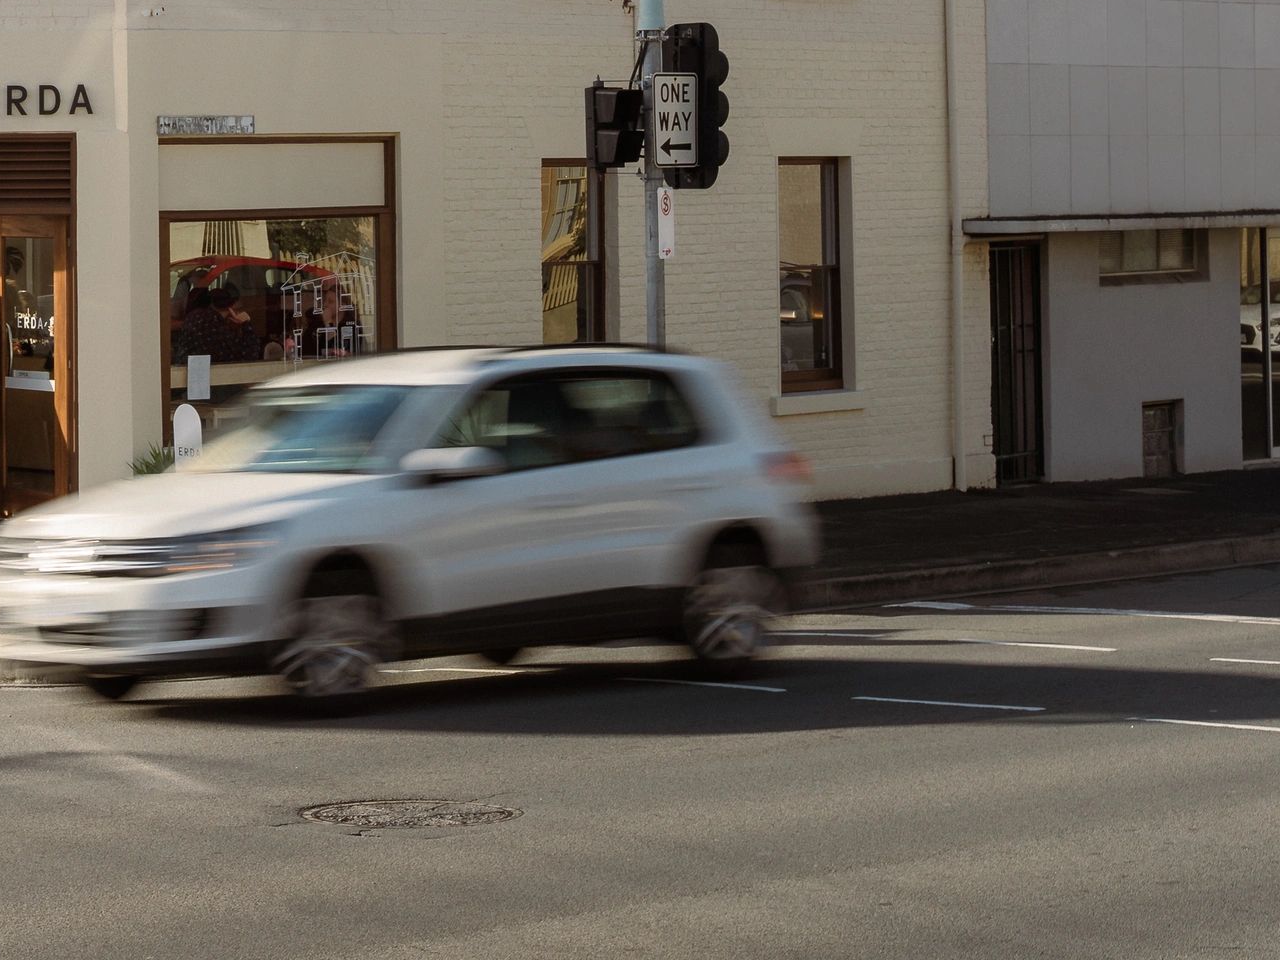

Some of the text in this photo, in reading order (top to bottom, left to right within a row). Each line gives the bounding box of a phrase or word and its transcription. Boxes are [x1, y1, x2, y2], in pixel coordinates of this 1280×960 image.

[660, 83, 690, 103] ONE
[658, 112, 692, 131] WAY
[17, 316, 44, 330] ERDA
